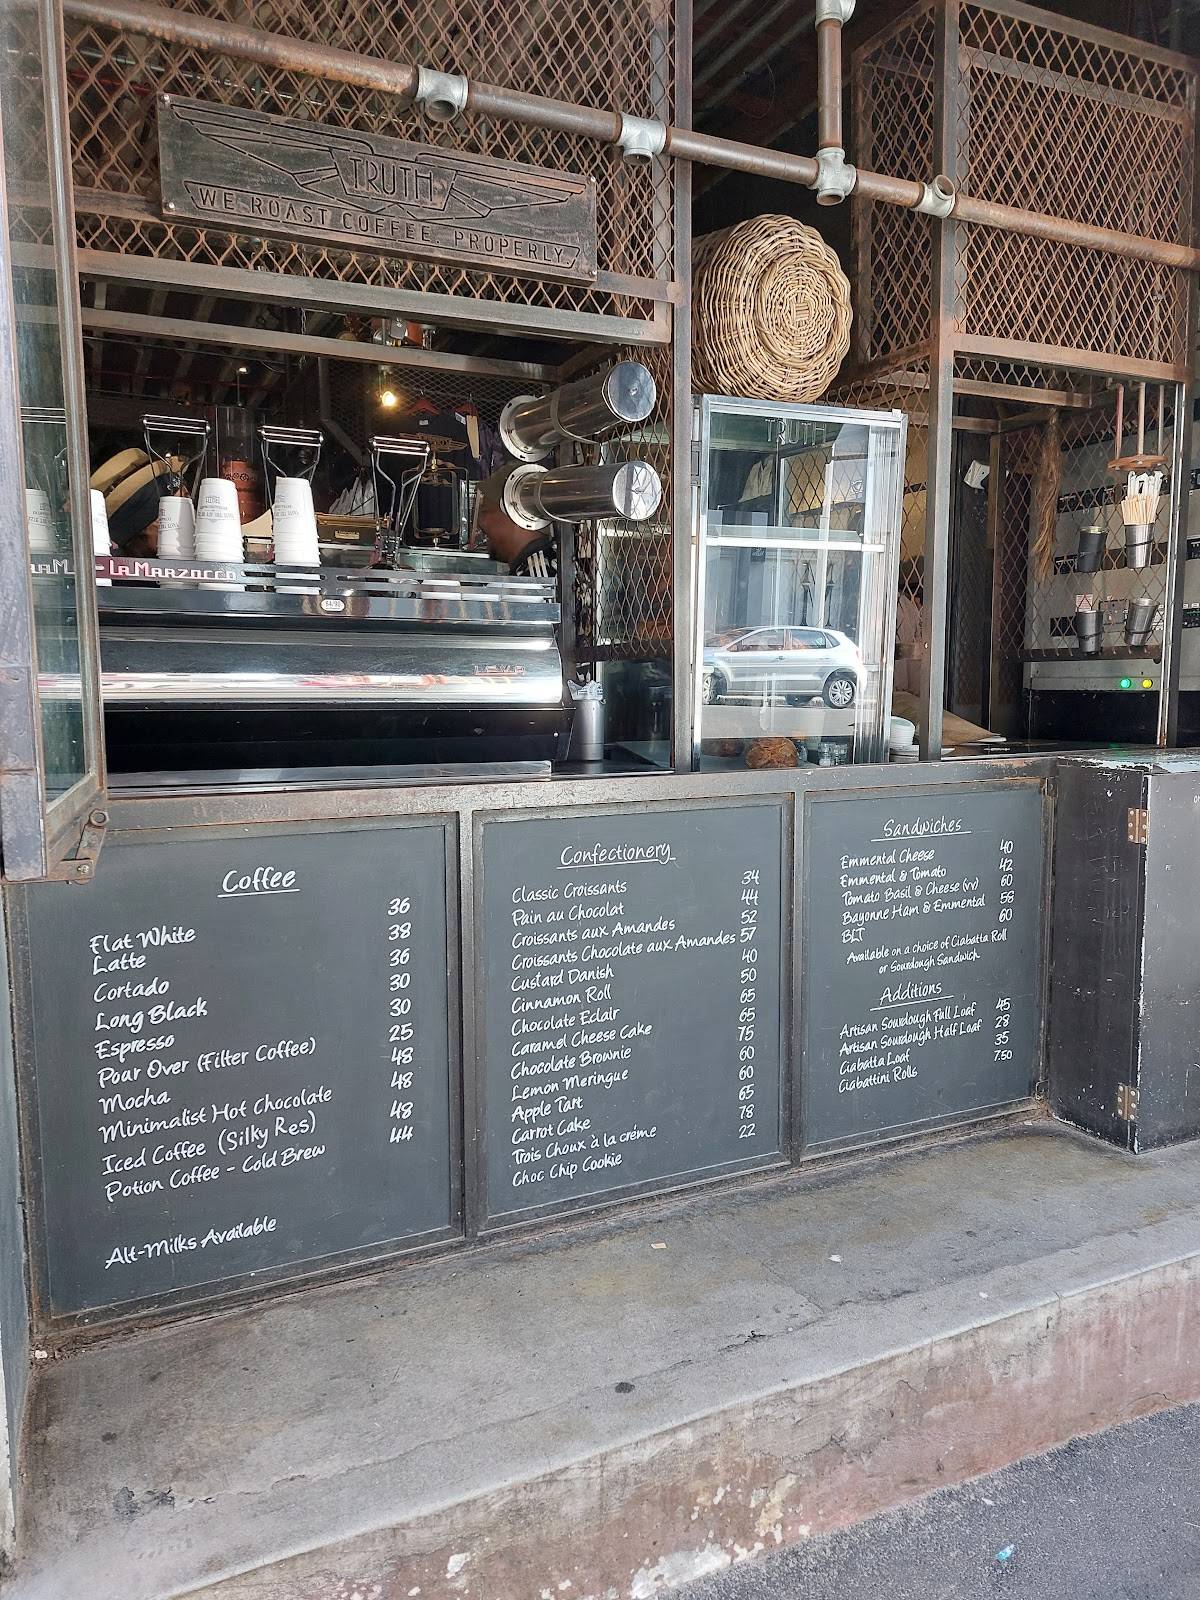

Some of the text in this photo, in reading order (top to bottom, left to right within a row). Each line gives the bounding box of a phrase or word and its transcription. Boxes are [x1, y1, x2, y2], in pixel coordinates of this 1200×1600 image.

[348, 157, 435, 202] TRUTH
[199, 187, 234, 208] WE
[251, 196, 327, 226] ROAST
[765, 418, 827, 446] TRUTH
[883, 816, 962, 837] Sandwiches
[560, 843, 671, 866] Confectionery
[1000, 839, 1013, 854] 40
[840, 848, 934, 869] Emmental Cheese
[999, 857, 1013, 872] 42
[222, 866, 297, 894] Coffee
[742, 869, 759, 885] 34
[840, 868, 896, 887] Emmental
[909, 865, 946, 880] Tomato
[1001, 873, 1013, 887] 60
[512, 880, 627, 903] Classic Croissants
[741, 889, 759, 905] 44
[842, 891, 879, 906] Tomato
[884, 885, 911, 902] Basil
[926, 880, 960, 896] Cheese
[1000, 890, 1014, 905] 58
[388, 897, 410, 915] 36
[512, 902, 624, 926] Pain au Chocolat
[741, 909, 757, 925] 52
[842, 909, 889, 926] Bayonne
[891, 903, 919, 919] Ham
[933, 894, 985, 912] Emmental
[999, 907, 1012, 923] 60
[89, 926, 196, 954] Flat White
[389, 922, 411, 940] 38
[512, 916, 675, 948] Croissants aux Amandes
[842, 927, 865, 943] BLT
[390, 948, 410, 966] 36
[512, 930, 736, 970] Croissants Chocolate aux Amandes
[742, 948, 757, 963] 40
[847, 927, 1007, 964] Available on a choice of Ciabatta Roll
[93, 952, 146, 975] Latte
[879, 948, 980, 975] or Sourdough Sandwich
[390, 973, 410, 991] 30
[511, 963, 614, 991] Custard Danish
[741, 968, 756, 983] 50
[94, 977, 169, 1002] Cortado
[512, 983, 611, 1013] Cinnamon Roll
[740, 988, 755, 1003] 65
[879, 980, 943, 1005] Additions
[95, 997, 207, 1033] Long Black
[390, 998, 411, 1016] 30
[739, 1007, 755, 1022] 65
[996, 997, 1010, 1012] 45
[512, 1014, 575, 1036] Chocolate
[840, 1024, 878, 1039] Artisan
[882, 1009, 932, 1030] Sourdough
[953, 1002, 976, 1018] Loaf
[995, 1013, 1010, 1029] 28
[389, 1023, 413, 1042] 25
[512, 1022, 652, 1056] Caramel Cheese Cake
[738, 1024, 754, 1041] 75
[840, 1019, 982, 1057] Artisan Sourdough Half Loaf
[995, 1030, 1009, 1046] 35
[95, 1035, 174, 1063] Espresso
[147, 1060, 189, 1078] Over
[197, 1050, 249, 1072] (Filter
[256, 1037, 315, 1061] Coffee)
[391, 1047, 413, 1065] 48
[739, 1045, 754, 1061] 60
[511, 1045, 631, 1079] Chocolate Brownie
[739, 1065, 753, 1080] 60
[840, 1048, 910, 1075] Ciabatta Loaf
[391, 1071, 413, 1090] 48
[511, 1070, 628, 1101] Lemon Meringue
[839, 1065, 917, 1093] Ciabattini Rolls
[99, 1088, 171, 1114] Mocha
[739, 1084, 754, 1100] 65
[98, 1086, 331, 1143] Minimalist Hot Chocolate
[390, 1100, 413, 1119] 48
[512, 1096, 583, 1124] Apple Tart
[739, 1104, 754, 1119] 78
[390, 1126, 413, 1143] 44
[512, 1117, 591, 1144] Carrot Cake
[739, 1123, 755, 1138] 22
[102, 1110, 315, 1175] Iced Coffee (Silky Res)
[512, 1147, 541, 1164] Trois
[546, 1141, 586, 1158] Choux
[604, 1132, 617, 1148] la
[105, 1180, 164, 1202] Potion
[170, 1165, 219, 1188] Coffee
[242, 1150, 277, 1172] Cold
[281, 1145, 325, 1166] Brew
[513, 1153, 622, 1186] Choc Chip Cookie
[200, 1216, 276, 1248] Available
